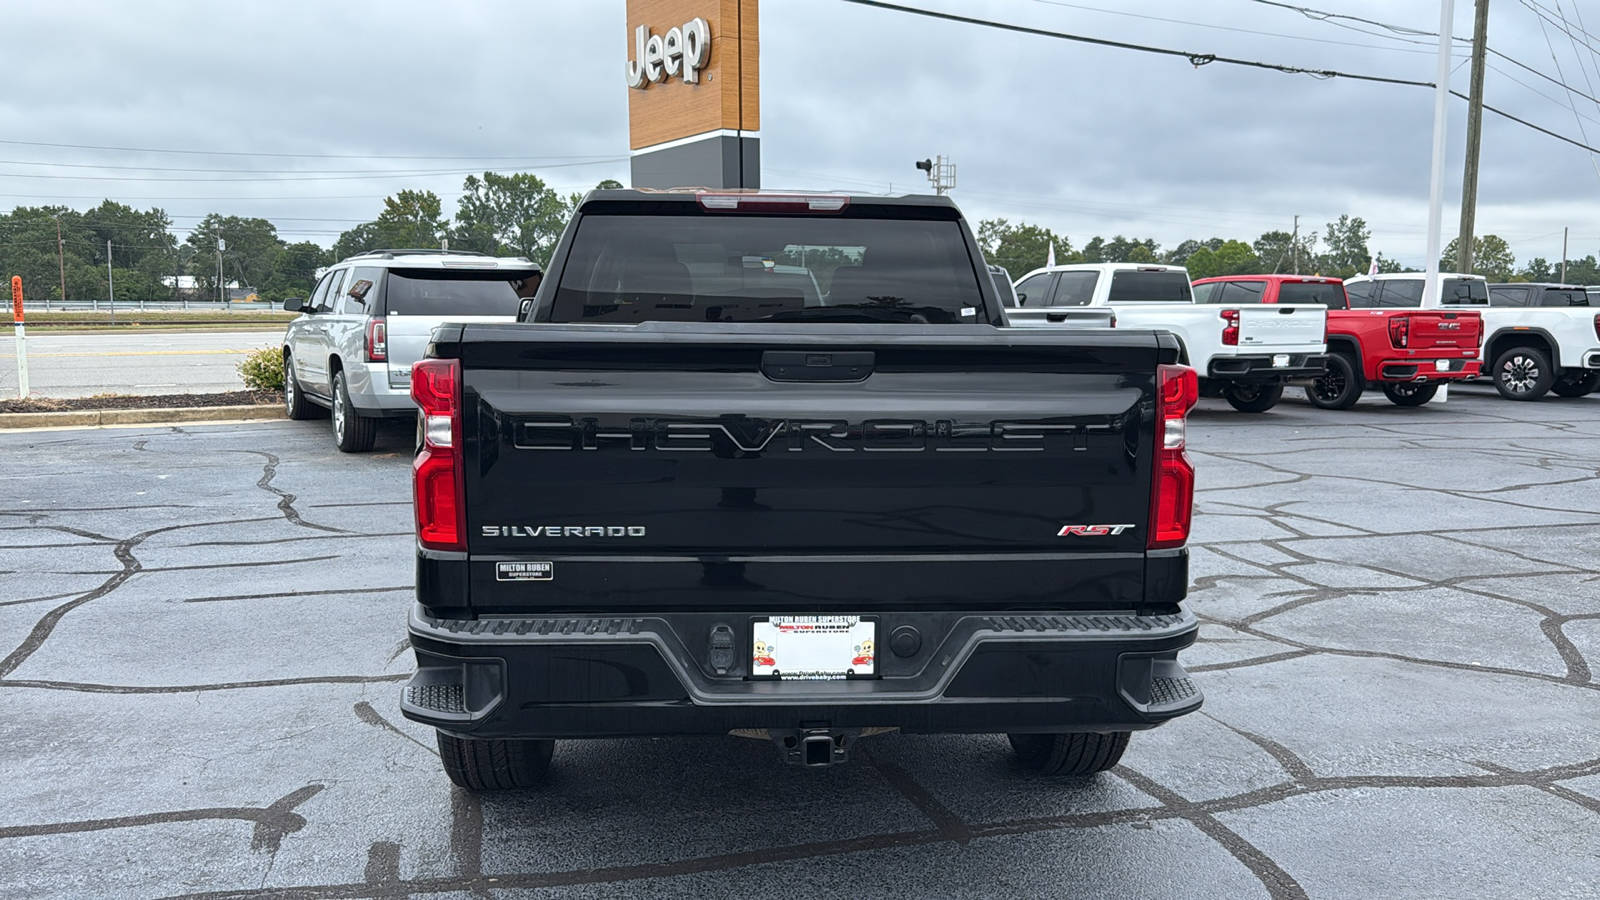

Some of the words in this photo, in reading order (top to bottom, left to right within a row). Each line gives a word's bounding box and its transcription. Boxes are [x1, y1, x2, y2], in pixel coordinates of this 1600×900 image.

[625, 17, 711, 89] Jeep
[1246, 320, 1322, 328] CHEVROLET
[512, 415, 1111, 452] CHEVROLET
[482, 525, 646, 537] SILVERADO
[1057, 524, 1136, 537] RST
[500, 563, 526, 572] MILTON
[527, 563, 550, 572] RUBEN
